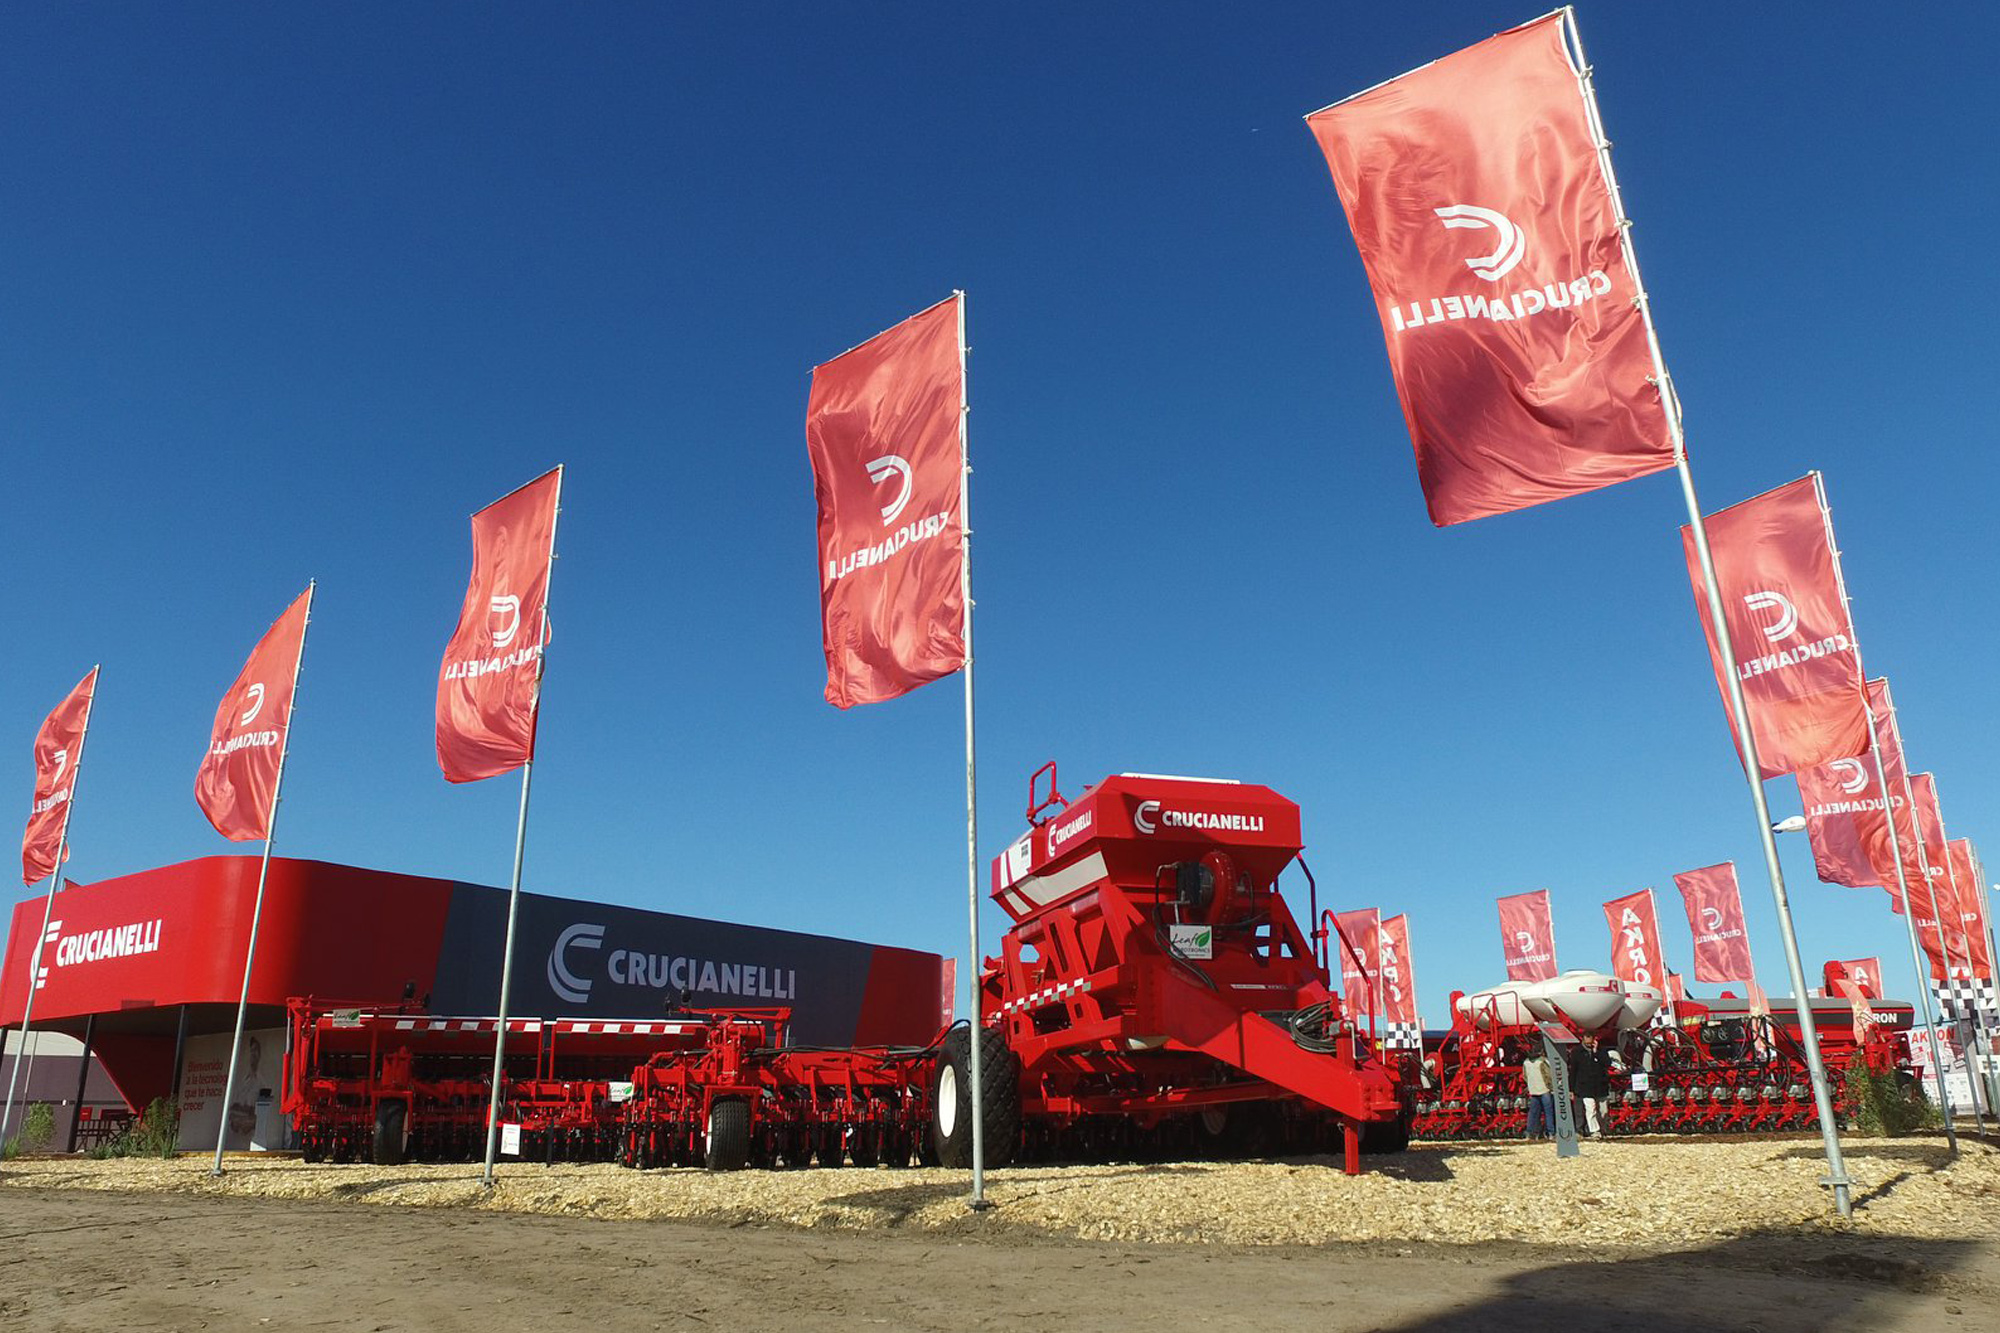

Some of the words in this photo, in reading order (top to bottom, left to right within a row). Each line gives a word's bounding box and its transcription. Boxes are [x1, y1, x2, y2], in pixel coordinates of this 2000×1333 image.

[1161, 810, 1264, 832] CRUCIANELLI
[56, 919, 162, 967] CRUCIANELLI
[607, 949, 796, 1000] CRUCIANELLI
[1911, 1028, 1956, 1045] AKON
[1554, 1057, 1567, 1121] CRUCIANELLI
